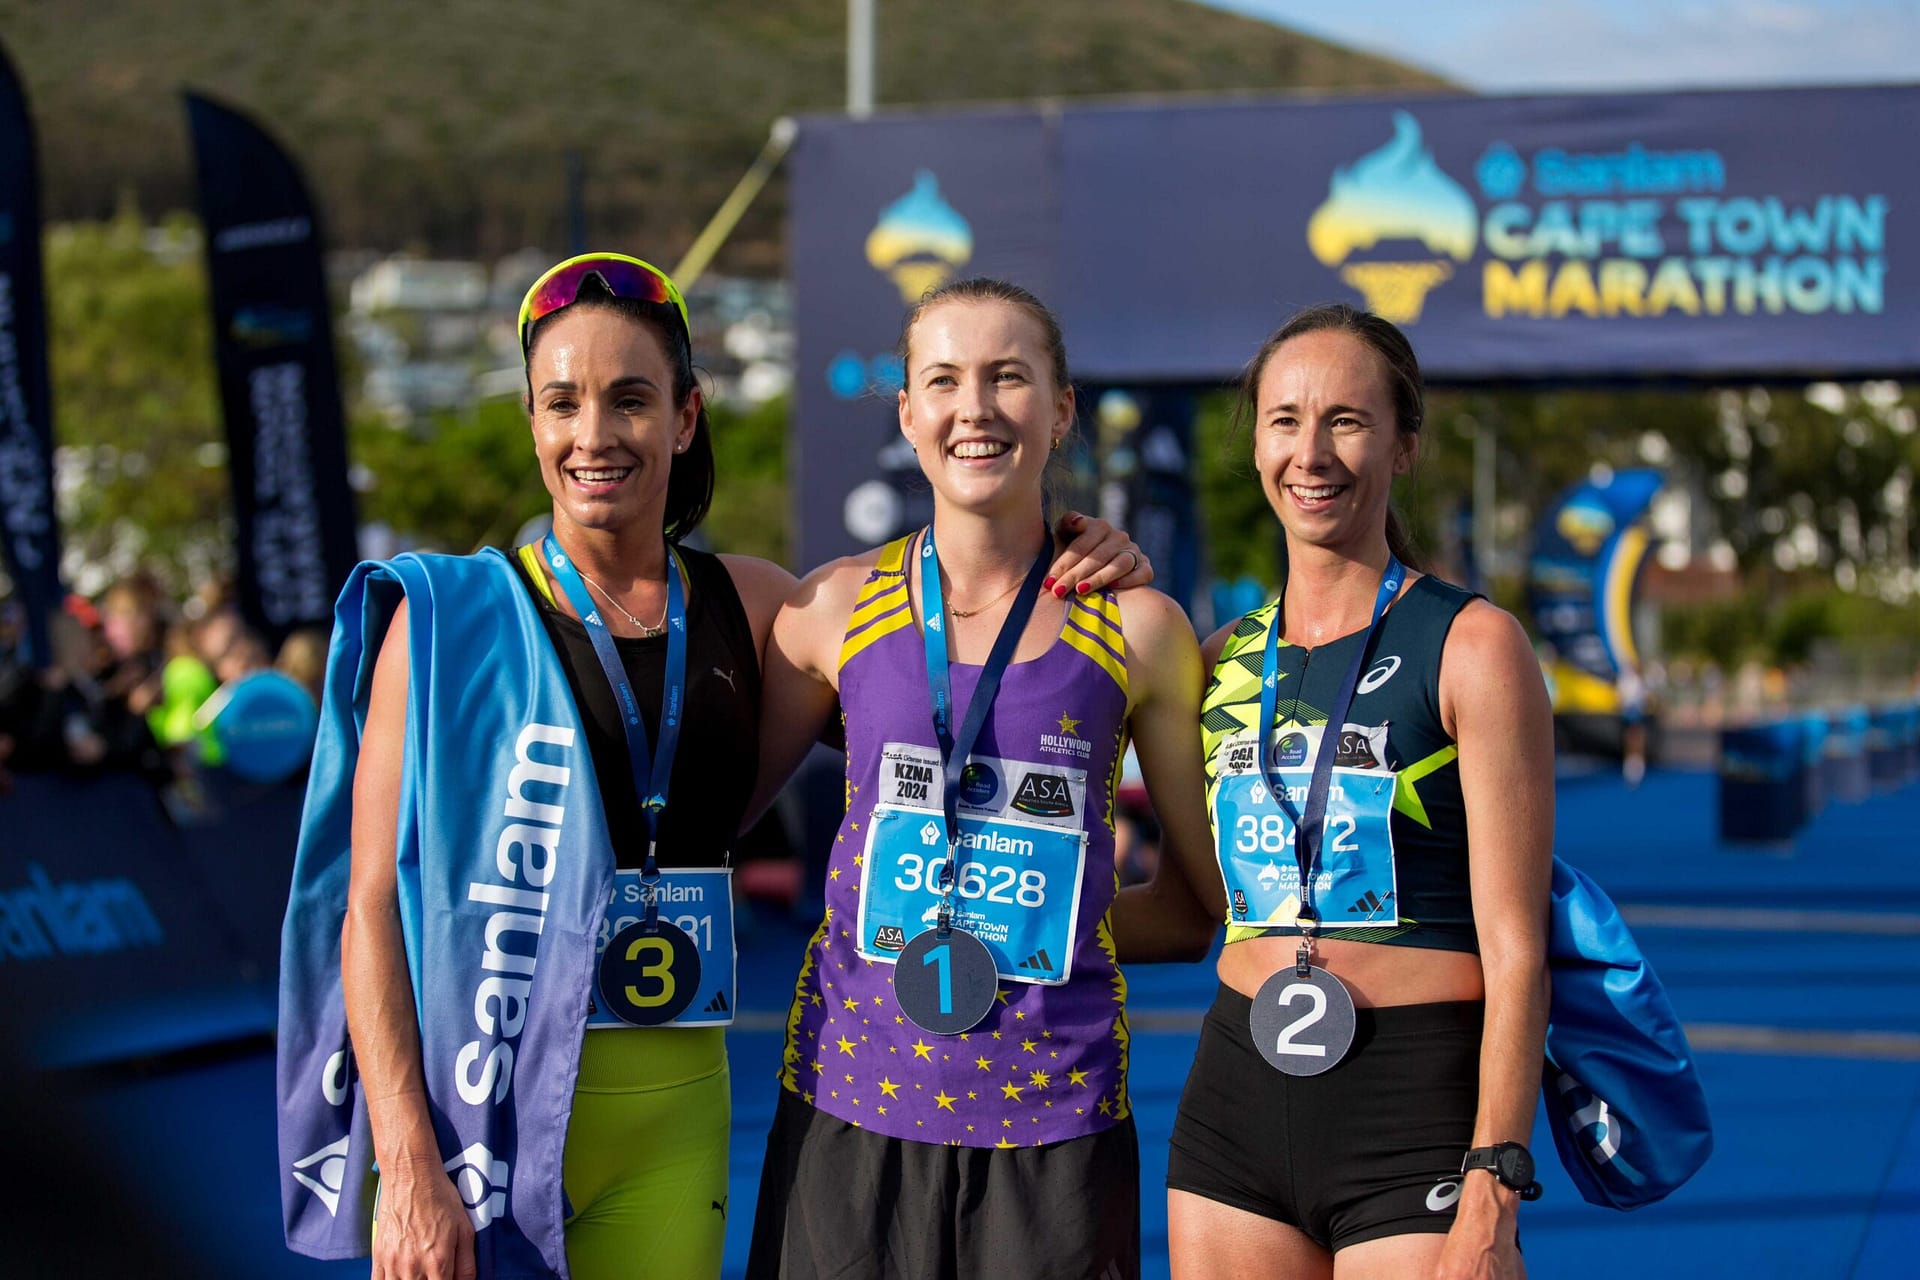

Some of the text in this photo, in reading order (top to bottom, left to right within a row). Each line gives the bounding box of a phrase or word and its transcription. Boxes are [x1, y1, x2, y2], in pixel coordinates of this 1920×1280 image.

[1535, 145, 1725, 194] Sanlam
[1484, 195, 1887, 258] CAPE TOWN
[1482, 257, 1885, 317] MARATHON
[619, 683, 635, 715] Sanlam
[669, 685, 679, 717] Sanlam
[936, 691, 945, 724] Sanlam
[1040, 746, 1090, 759] ATHLETICS CLUB
[1041, 734, 1091, 752] HOLLYWOOD
[1231, 747, 1253, 761] CGA
[1336, 735, 1368, 754] SA
[895, 763, 933, 783] KZNA
[897, 781, 928, 800] 2024
[1021, 777, 1067, 801] ASA
[1272, 783, 1344, 802] Sanm
[624, 882, 704, 903] Sanlam
[894, 853, 1047, 908] 30628
[454, 722, 575, 1106] Sanlam
[957, 910, 985, 920] Sanlam
[877, 927, 903, 942] ASA
[978, 921, 1009, 934] TOWN
[624, 936, 676, 1008] 3
[923, 943, 953, 1014] 1
[1276, 983, 1327, 1057] 2
